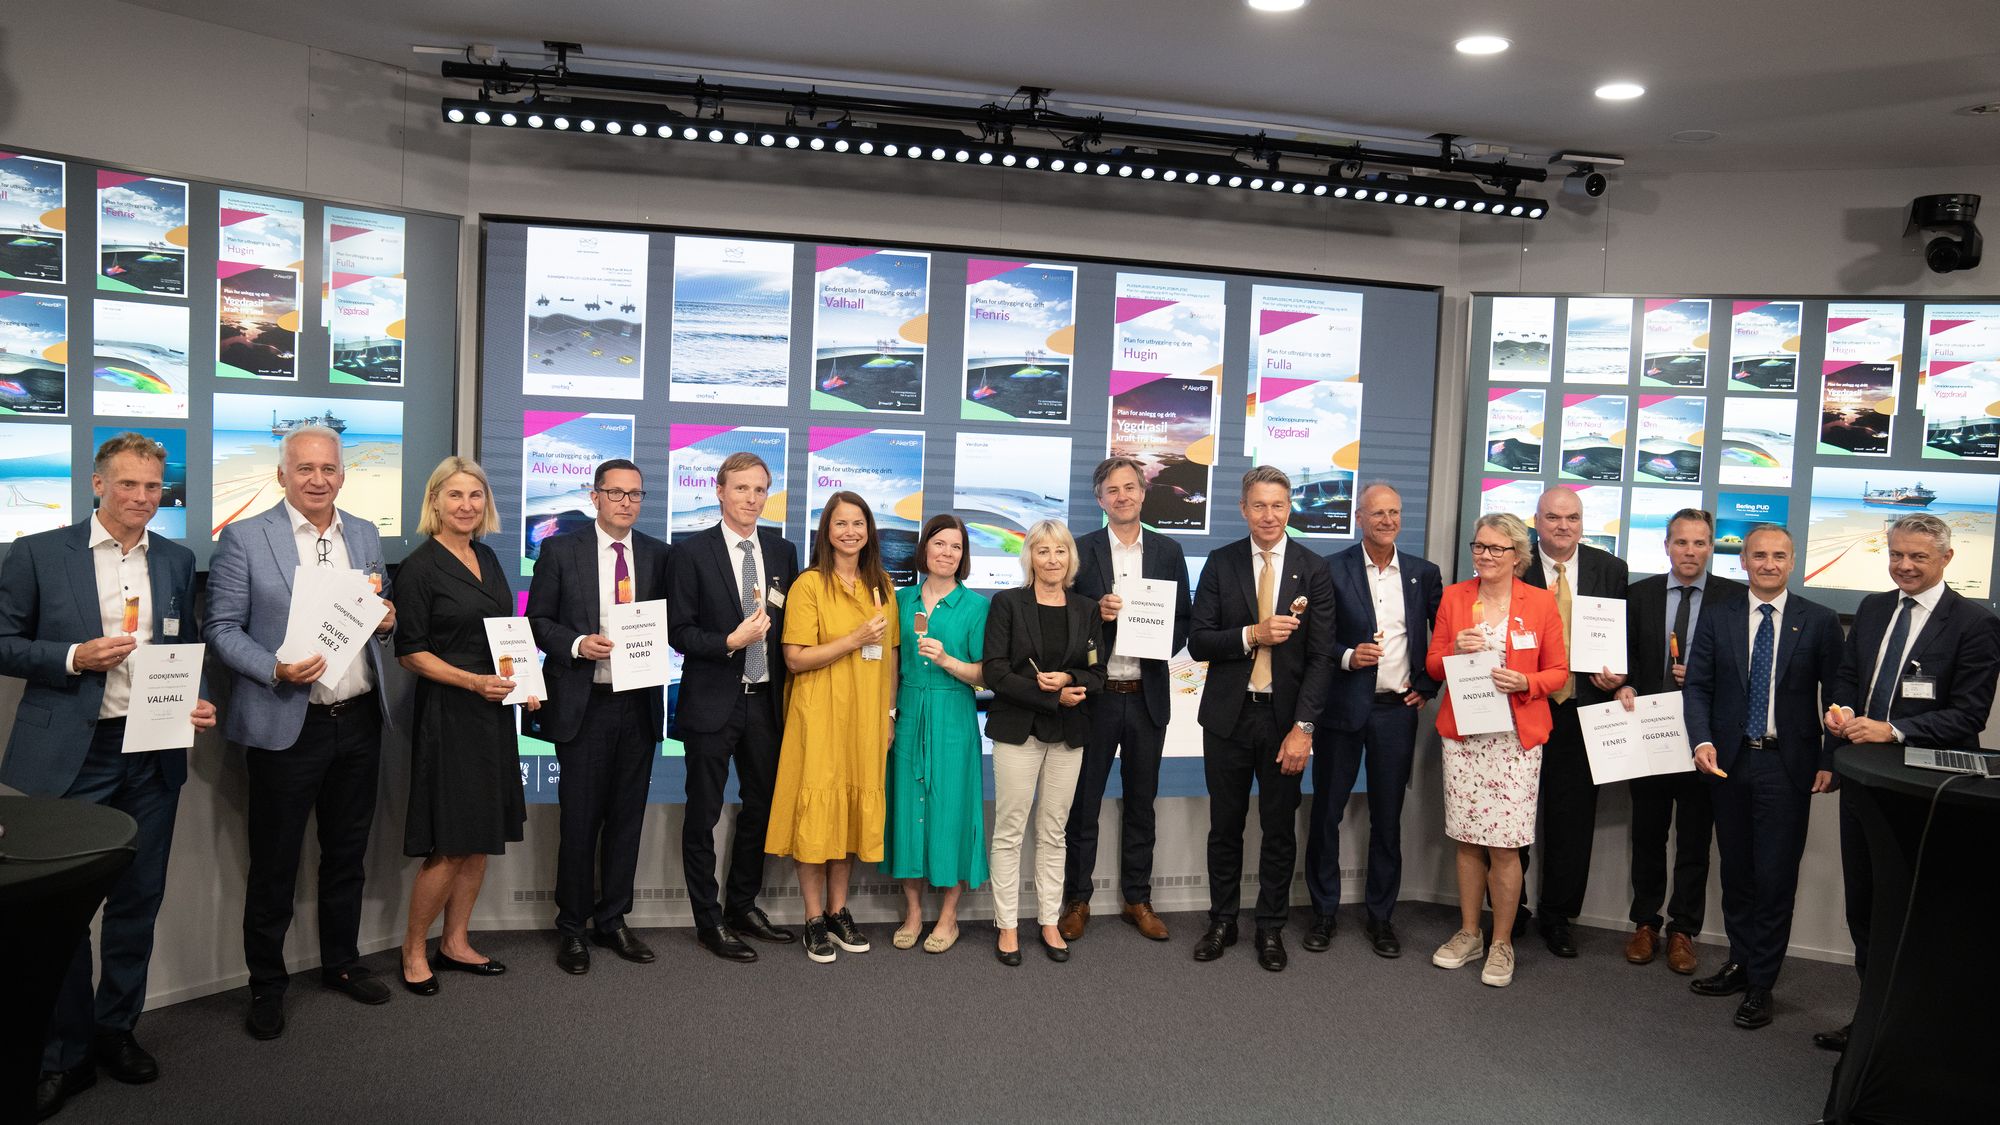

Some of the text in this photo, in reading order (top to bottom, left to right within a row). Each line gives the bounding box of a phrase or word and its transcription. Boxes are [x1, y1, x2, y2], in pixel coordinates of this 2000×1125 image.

[106, 207, 135, 219] Fenris
[227, 244, 254, 256] Hugin
[336, 259, 354, 268] Fulla
[825, 297, 864, 310] Valhall
[975, 309, 1010, 320] Fenris
[1146, 339, 1172, 347] utbygging
[1124, 347, 1158, 362] Hugin
[1267, 358, 1292, 370] Fulla
[1116, 420, 1168, 433] Yggdrasil
[1116, 432, 1135, 442] kraft
[1268, 426, 1310, 439] Yggdrasil
[555, 452, 582, 460] utbygging
[532, 462, 592, 474] Alve Nord
[842, 466, 870, 474] utbygging
[680, 476, 706, 487] Idun
[818, 475, 842, 488] Ørn
[334, 602, 364, 628] GODKJENNING
[622, 622, 656, 630] GODKJENNING
[1128, 616, 1164, 626] VERDANDE
[322, 622, 350, 644] SOLVEIG
[318, 632, 334, 648] FASE
[626, 640, 652, 650] DVALIN
[629, 650, 650, 659] NORD
[147, 694, 184, 704] VALHALL
[1462, 692, 1495, 700] ANDVARE
[1640, 716, 1675, 724] GODKJENNING
[1594, 721, 1628, 730] GODKJENNING
[1602, 738, 1627, 746] FENRIS
